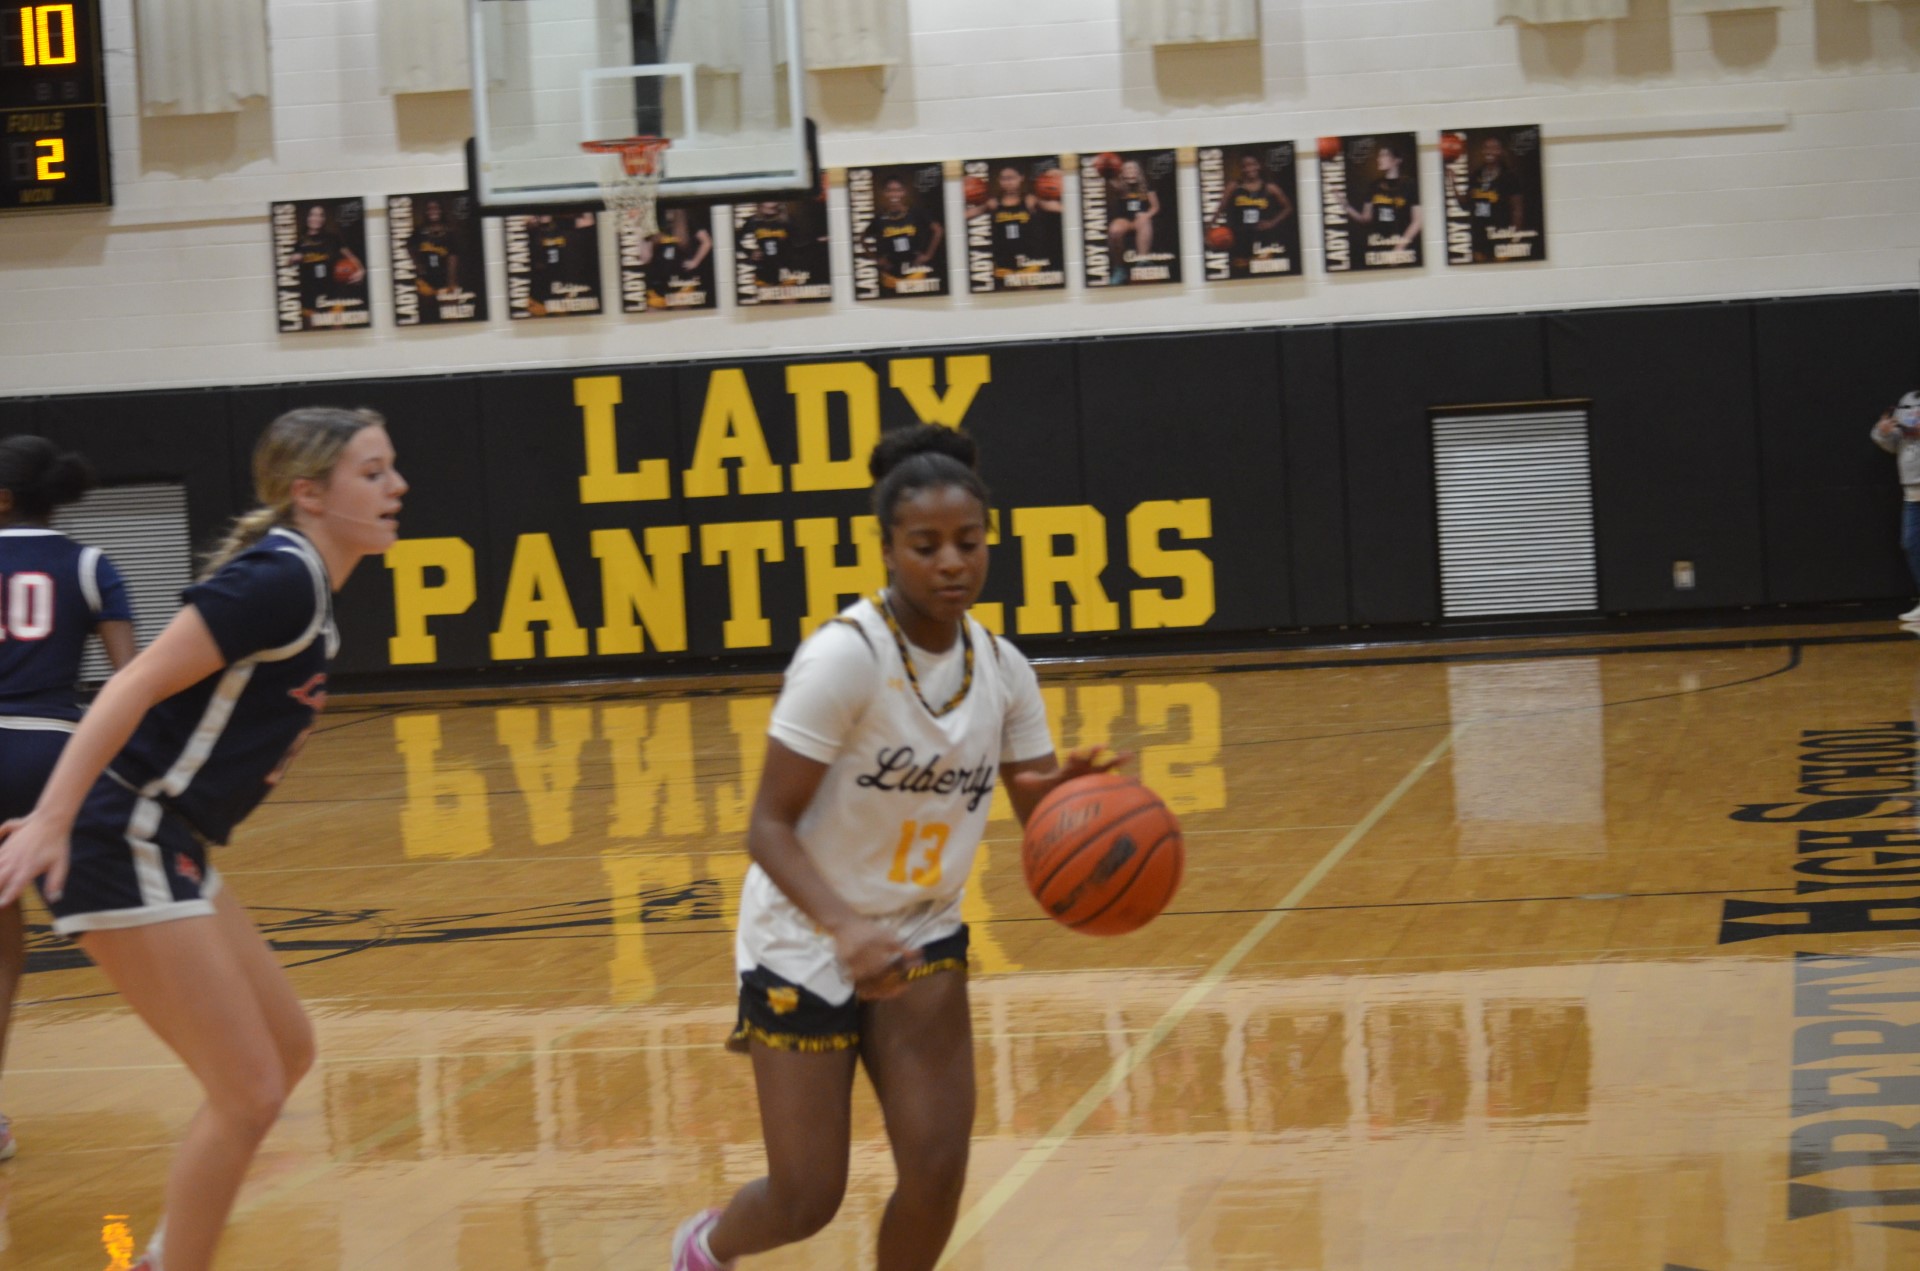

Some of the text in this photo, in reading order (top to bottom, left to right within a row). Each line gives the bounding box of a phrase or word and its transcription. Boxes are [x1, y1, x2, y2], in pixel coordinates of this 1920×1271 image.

[21, 4, 76, 66] 10
[8, 112, 65, 132] FOULS
[35, 138, 66, 180] 2
[1325, 230, 1351, 271] LADY
[1447, 222, 1473, 263] LADY
[854, 258, 879, 299] LADY
[969, 251, 994, 292] LADY
[1085, 245, 1110, 286] LADY
[279, 290, 303, 331] LADY
[395, 283, 420, 325] LADY
[622, 270, 647, 312] LADY
[573, 354, 991, 504] LADY
[384, 497, 1215, 665] PANTHRS
[857, 746, 993, 812] Liberty
[1728, 721, 1919, 823] SCHOOL
[887, 819, 950, 887] 13
[1718, 829, 1920, 945] HIGH
